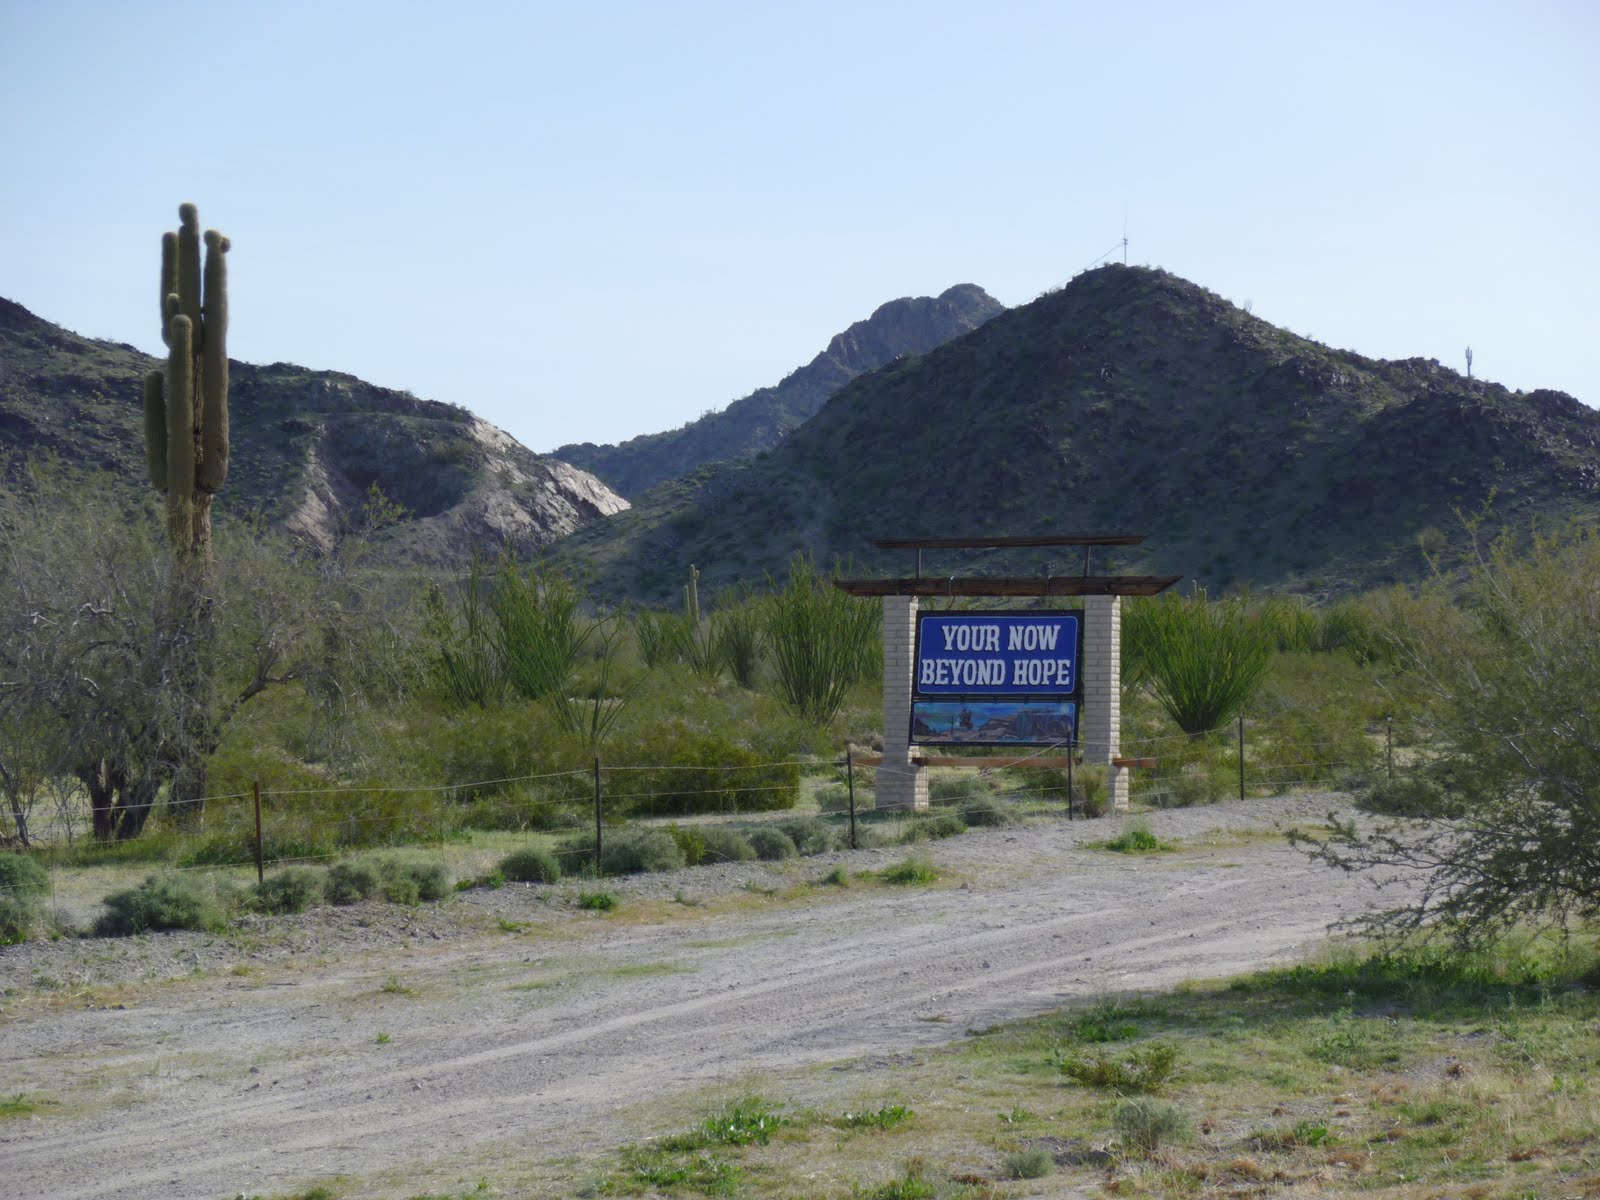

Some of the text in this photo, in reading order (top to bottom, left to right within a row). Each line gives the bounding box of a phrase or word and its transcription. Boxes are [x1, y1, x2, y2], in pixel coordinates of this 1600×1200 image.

[942, 625, 1061, 651] YOUR NOW
[920, 659, 1070, 686] BEYOND HOPE
